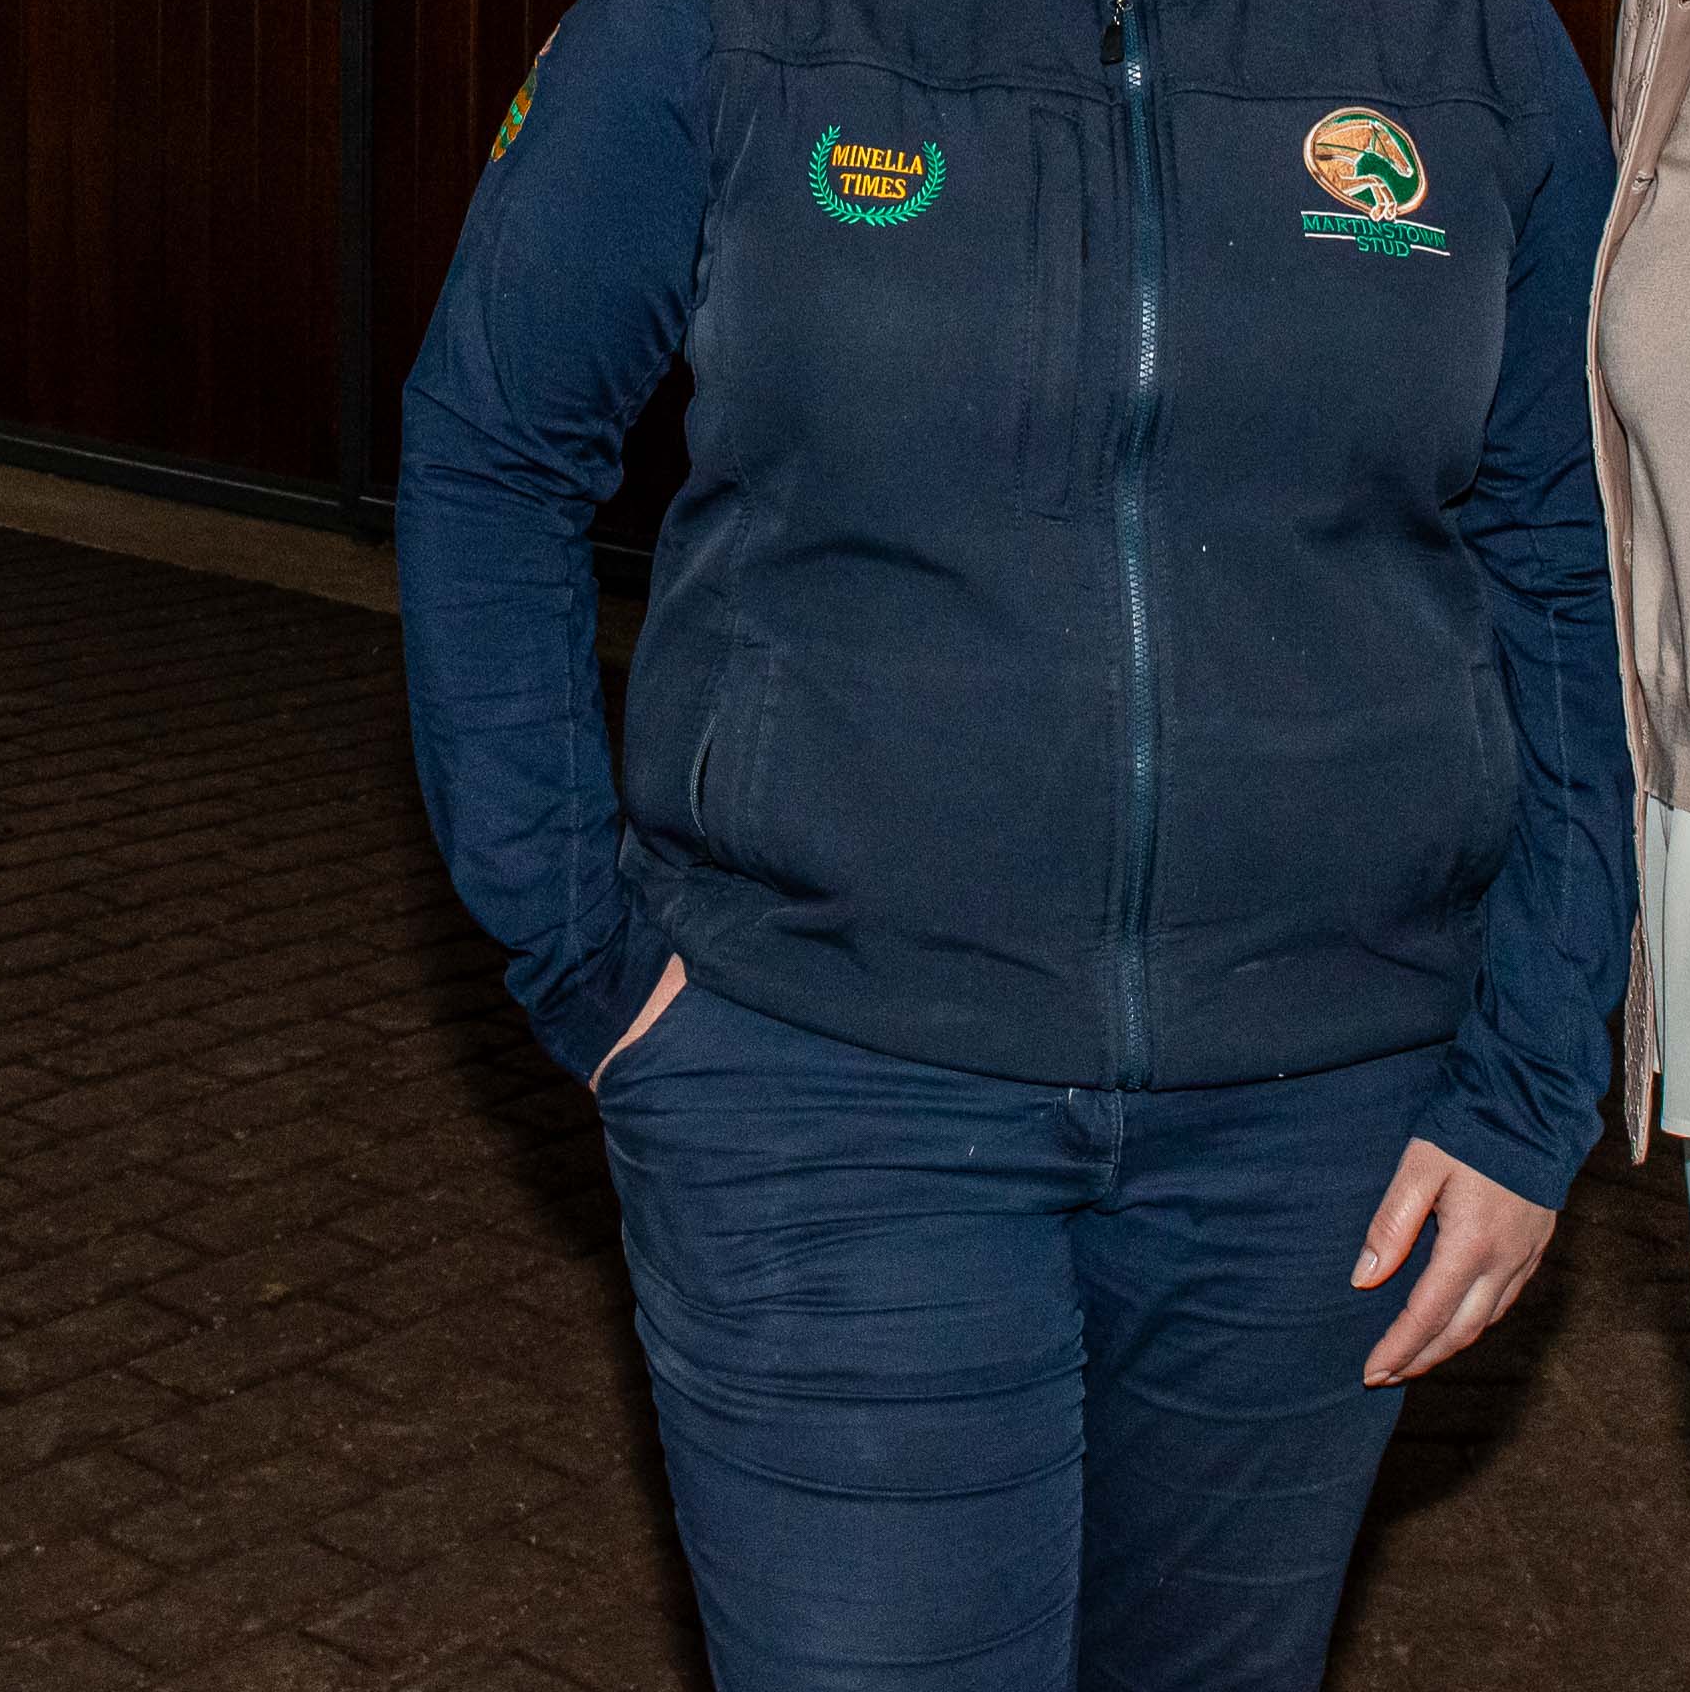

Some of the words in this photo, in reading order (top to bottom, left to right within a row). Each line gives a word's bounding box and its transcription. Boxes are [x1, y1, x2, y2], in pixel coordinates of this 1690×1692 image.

[831, 144, 924, 176] MINELLA
[840, 172, 908, 200] TIMES
[1302, 213, 1447, 248] MARTINSTOWN
[1356, 234, 1411, 258] STUD
